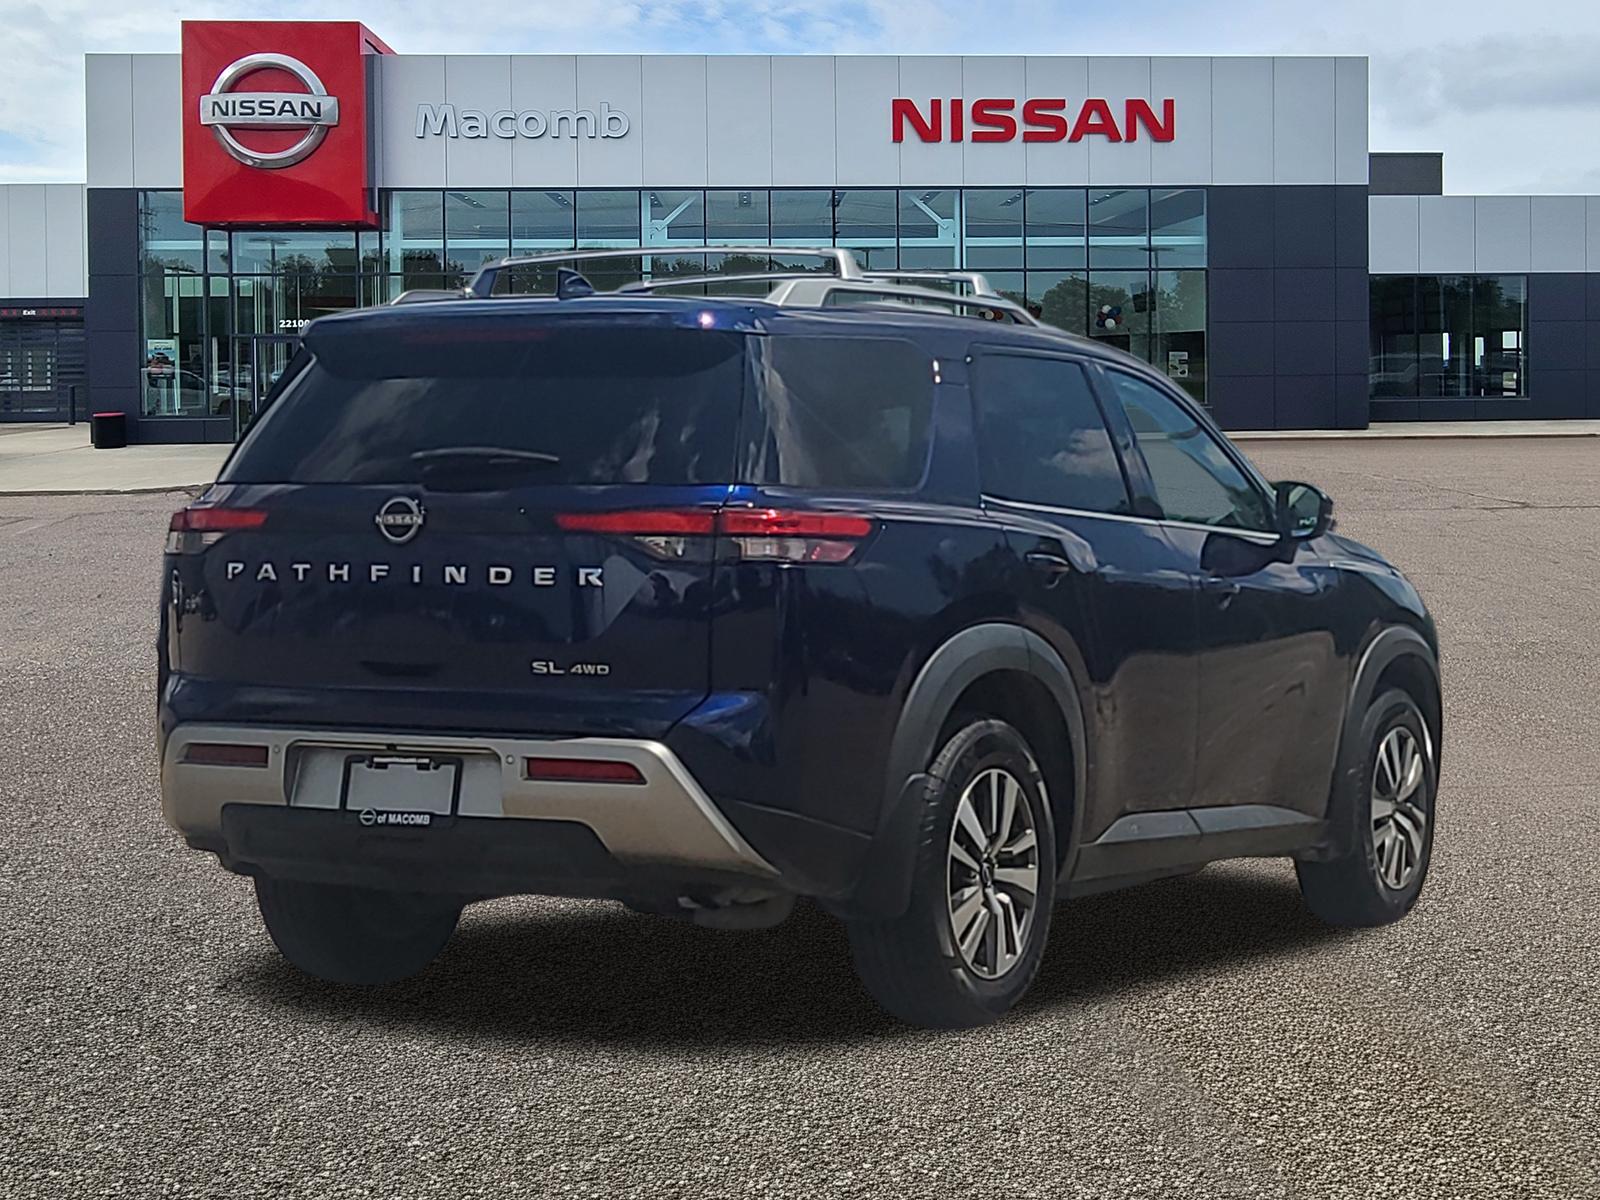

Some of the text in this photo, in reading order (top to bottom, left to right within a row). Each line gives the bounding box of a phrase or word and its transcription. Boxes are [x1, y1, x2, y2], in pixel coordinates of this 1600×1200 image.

[212, 100, 321, 117] NISSAN
[415, 101, 630, 139] Macomb
[892, 98, 1175, 143] NISSAN
[226, 562, 604, 587] PATHFINDER
[532, 661, 610, 675] SL 4WD
[388, 813, 431, 825] MACOMB
